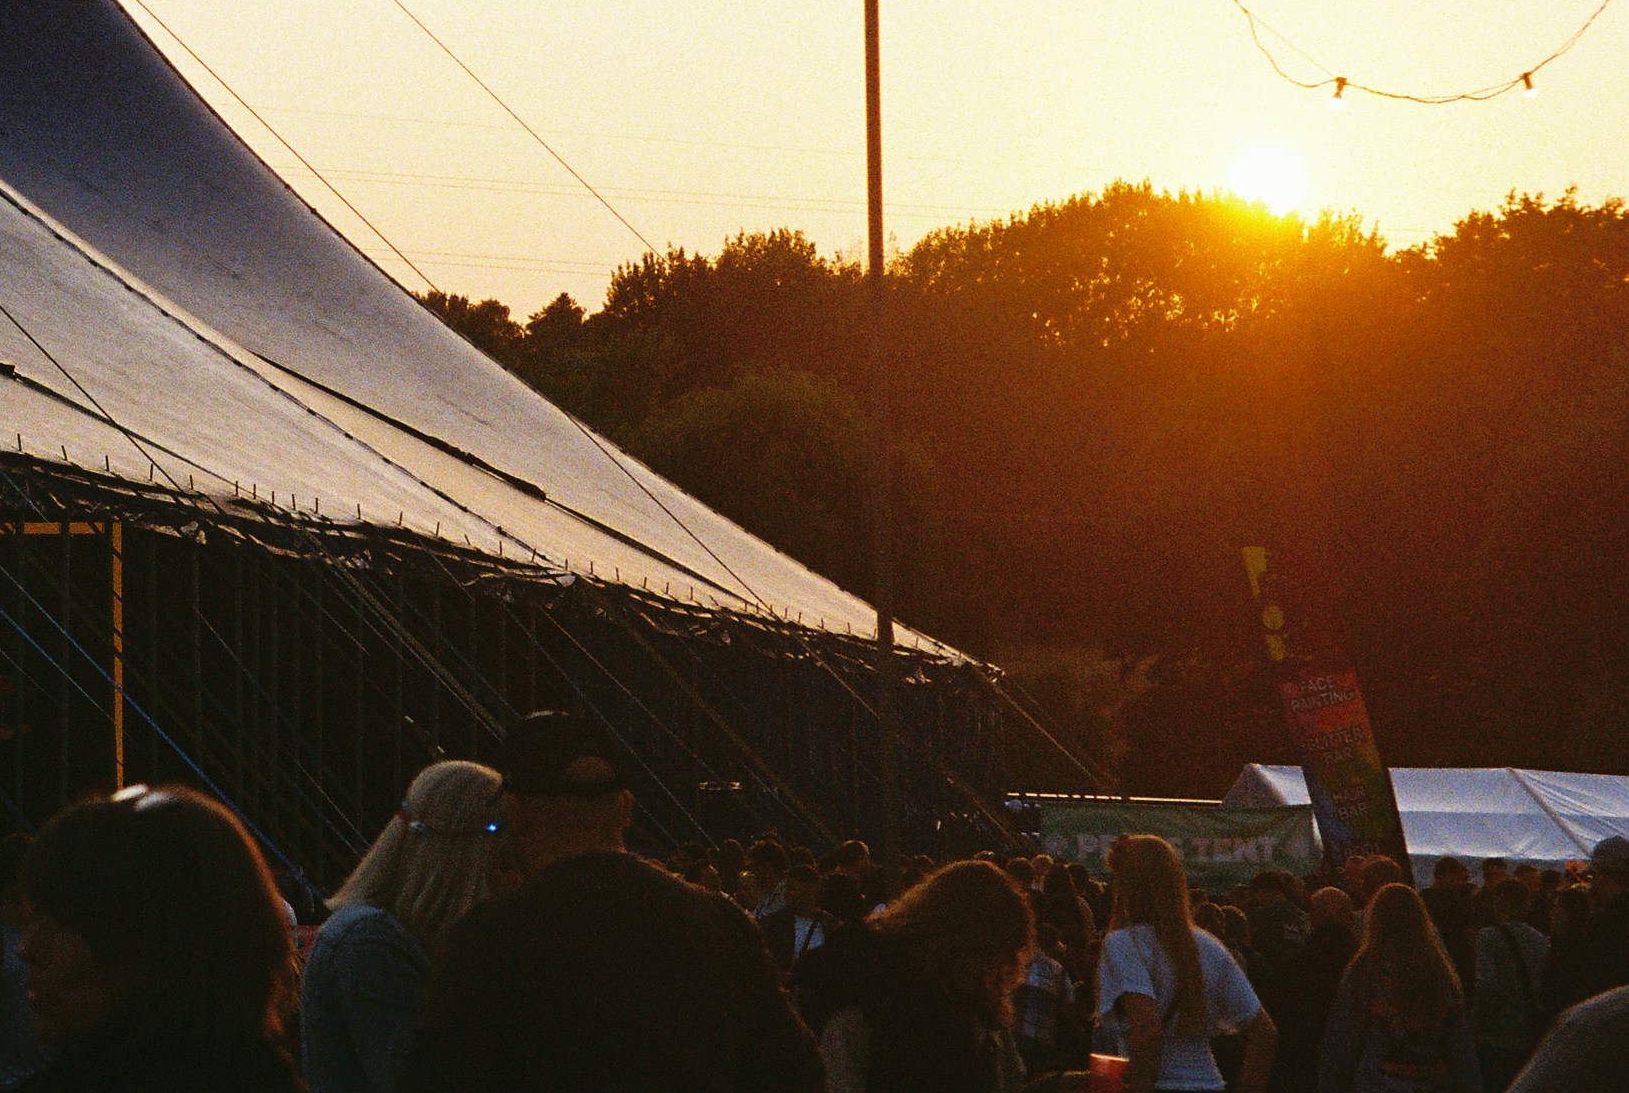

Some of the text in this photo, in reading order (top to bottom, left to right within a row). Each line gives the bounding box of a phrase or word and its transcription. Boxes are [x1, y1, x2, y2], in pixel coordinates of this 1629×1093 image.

[1300, 676, 1335, 693] FACE
[1291, 691, 1355, 711] PAINTING
[1338, 803, 1368, 819] BAR
